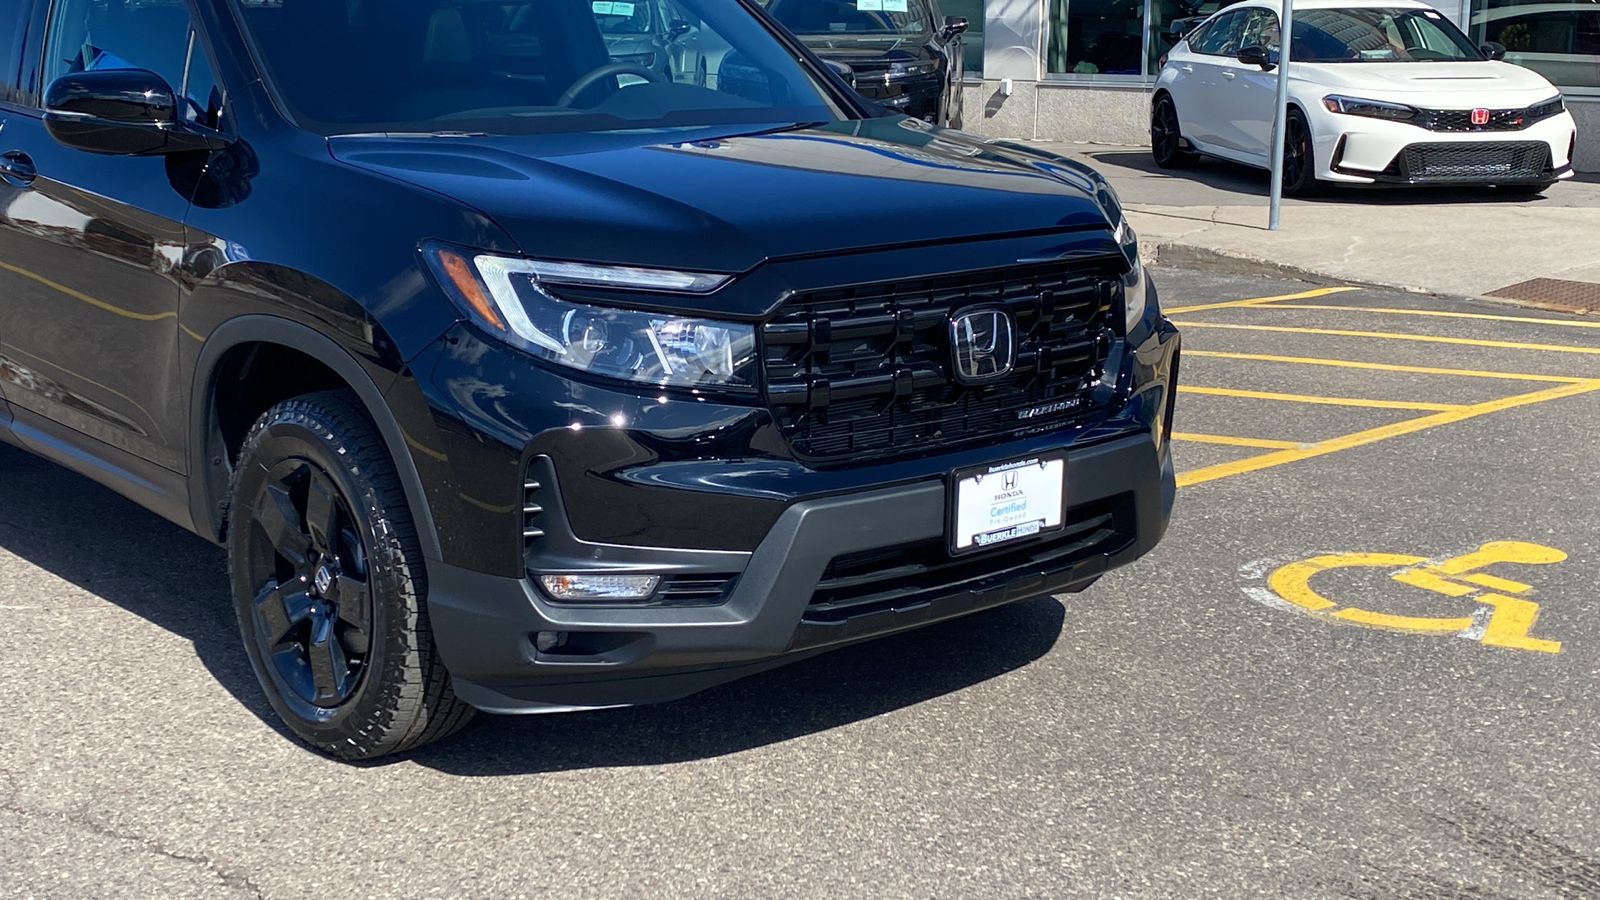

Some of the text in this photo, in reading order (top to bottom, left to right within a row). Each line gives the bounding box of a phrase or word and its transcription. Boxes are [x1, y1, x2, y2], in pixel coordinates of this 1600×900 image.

[994, 489, 1024, 501] HONDA
[990, 500, 1027, 517] Certified
[989, 512, 1027, 526] Pre-Owned
